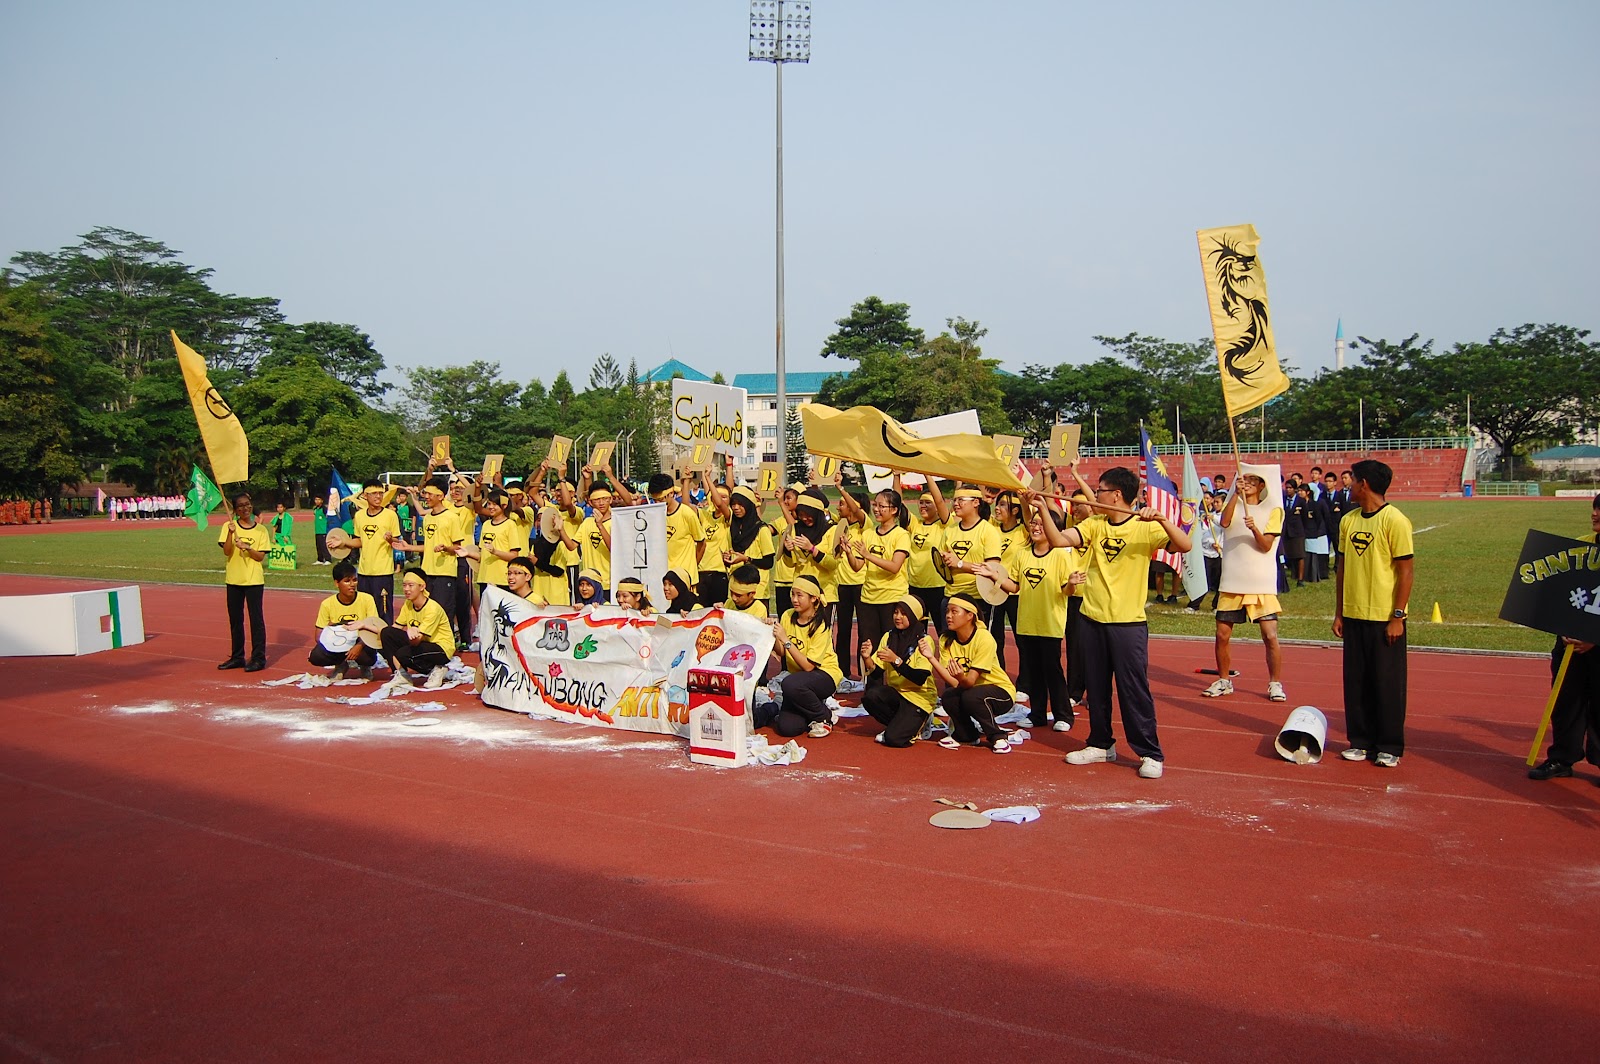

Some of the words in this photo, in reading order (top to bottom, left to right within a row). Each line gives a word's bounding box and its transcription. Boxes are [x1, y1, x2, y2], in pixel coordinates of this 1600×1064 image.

[674, 395, 743, 448] Santubong
[435, 441, 446, 460] S
[484, 460, 496, 477] A
[551, 441, 567, 462] N
[593, 448, 608, 466] T
[693, 444, 711, 465] U
[760, 468, 778, 491] B
[548, 631, 563, 641] TAR
[608, 686, 661, 719] ANTI
